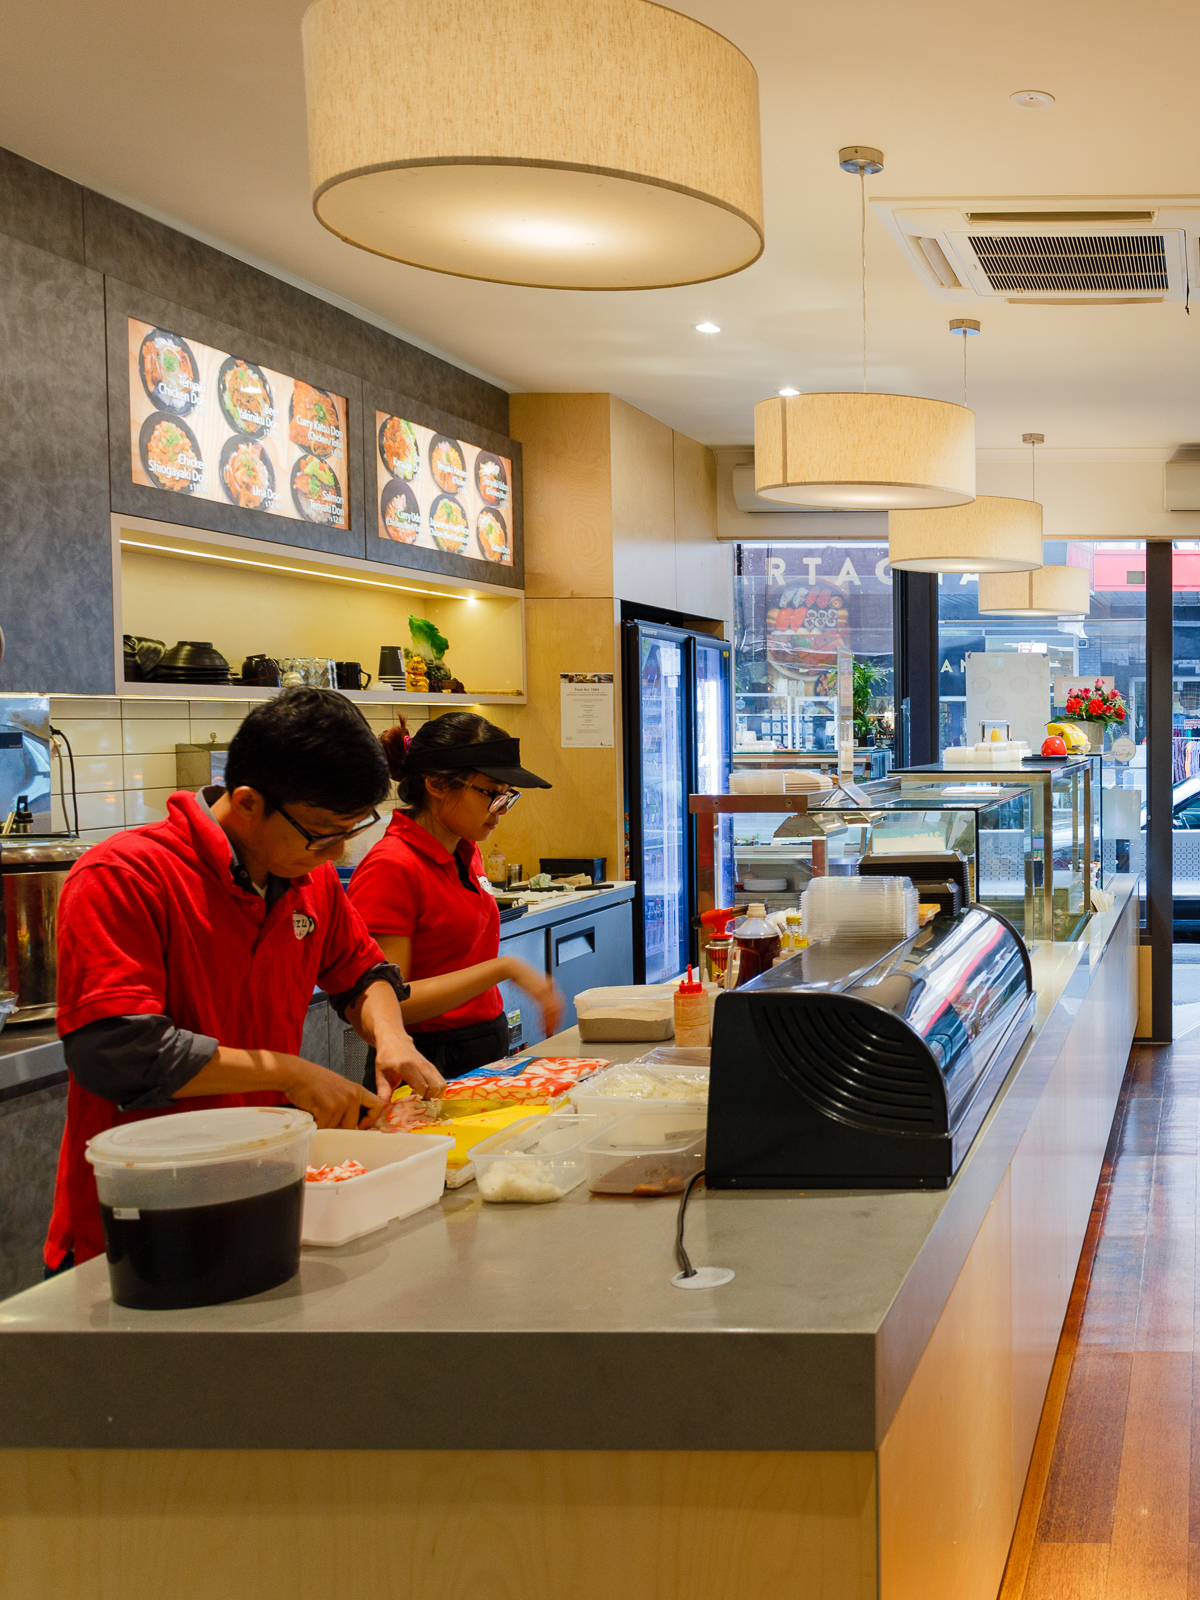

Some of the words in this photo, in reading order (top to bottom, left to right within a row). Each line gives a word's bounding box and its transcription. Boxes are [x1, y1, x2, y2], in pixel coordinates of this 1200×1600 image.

[178, 374, 206, 394] Teriyaki
[158, 382, 190, 402] Chicken
[190, 393, 206, 406] Don
[237, 406, 265, 427] Yakiniku
[265, 417, 280, 430] Don
[264, 404, 280, 418] Beef
[296, 414, 314, 432] Curry
[313, 420, 330, 434] Katsu
[331, 425, 343, 439] Don
[148, 459, 191, 481] Shiogayaki
[192, 470, 208, 484] Don
[177, 453, 208, 471] Chicken
[252, 485, 267, 499] Una
[267, 489, 281, 502] Don
[322, 490, 344, 505] Salmon
[309, 499, 331, 515] Teriyaki
[331, 504, 344, 517] Don
